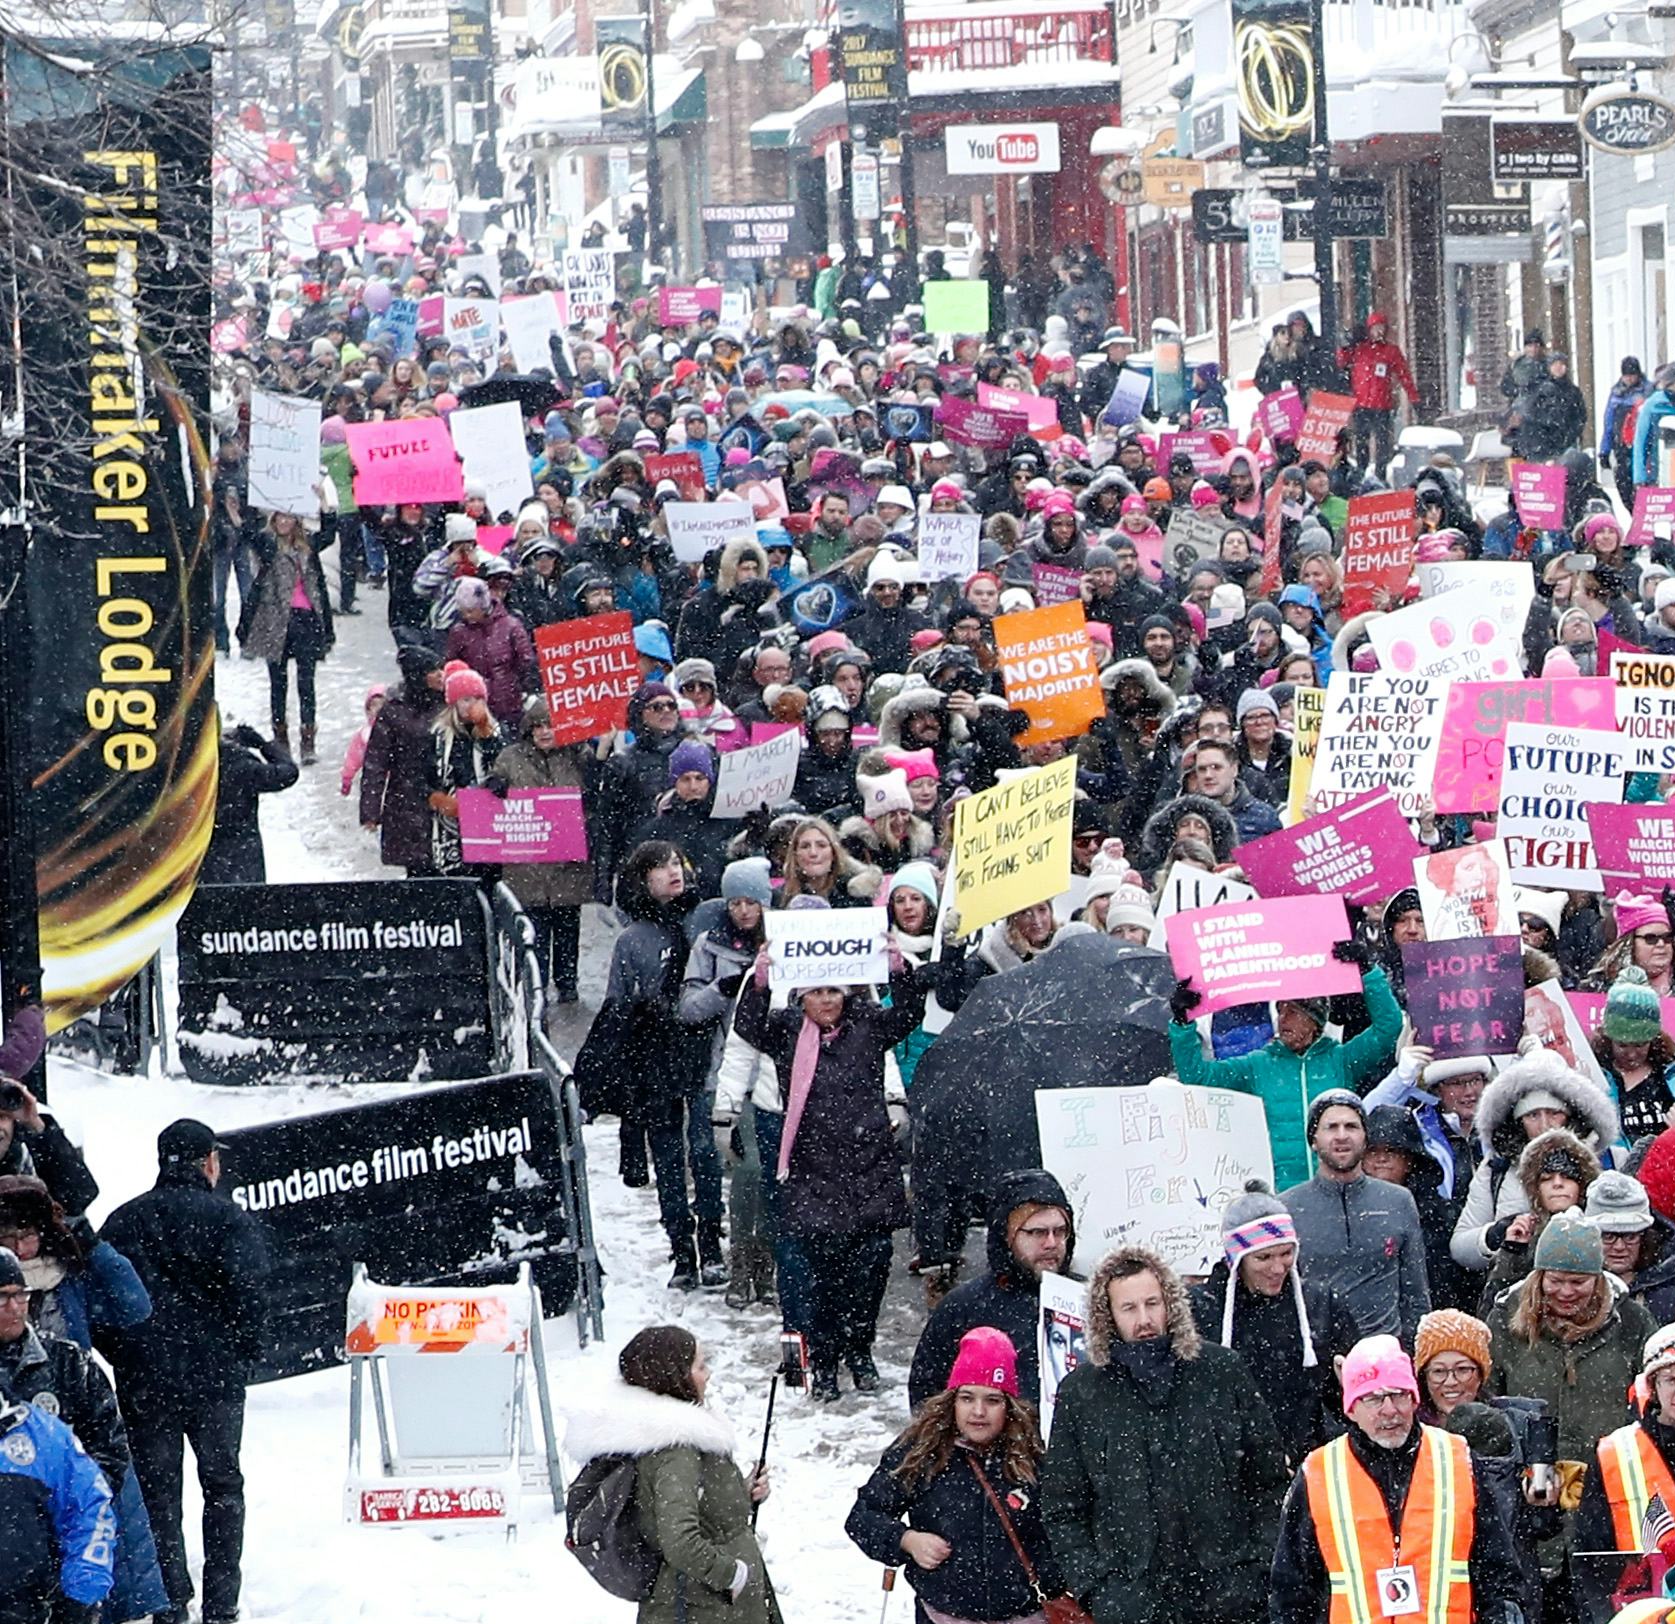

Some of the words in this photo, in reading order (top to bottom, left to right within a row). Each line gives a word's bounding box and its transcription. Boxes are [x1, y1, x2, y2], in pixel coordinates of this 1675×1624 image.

[1595, 107, 1666, 129] PEARLS
[967, 135, 1037, 162] YouTube
[368, 439, 430, 460] FUTURE
[651, 463, 699, 481] WOMEN
[1350, 515, 1370, 528] THE
[1372, 508, 1412, 526] FUTURE
[1349, 529, 1364, 548] IS
[1368, 527, 1411, 548] STILL
[1347, 550, 1410, 572] FEMALE
[543, 644, 572, 660] THE
[574, 632, 630, 650] FUTURE
[1000, 642, 1025, 659] WE
[1027, 636, 1055, 655] ARE
[1057, 629, 1086, 649] THE
[86, 556, 171, 772] Lodge
[547, 666, 568, 685] IS
[571, 652, 635, 674] STILL
[1004, 648, 1091, 685] NOISY
[551, 676, 640, 712] FEMALE
[1008, 674, 1096, 703] MAJORITY
[1350, 678, 1371, 693] IF
[1385, 678, 1428, 695] YOU
[1337, 698, 1386, 714] ARE
[1391, 698, 1438, 714] NOT
[1634, 697, 1653, 713] IS
[1347, 715, 1424, 733] ANGRY
[740, 740, 793, 764] MARCH
[1325, 736, 1376, 752] THEN
[1380, 735, 1431, 751] YOU
[1331, 753, 1376, 770] ARE
[1380, 753, 1421, 769] NOT
[1508, 746, 1622, 778] FUTURE
[1636, 746, 1656, 766] IN
[727, 776, 788, 805] WOMEN
[1021, 768, 1070, 802] BELIEVE
[1341, 771, 1417, 788] PAYING
[963, 835, 991, 858] STILL
[996, 818, 1026, 842] HAVE
[1027, 836, 1052, 864] SHIT
[1204, 912, 1263, 931] STAND
[201, 927, 316, 954] sundance
[321, 923, 369, 950] film
[374, 920, 462, 948] festival
[784, 939, 872, 957] ENOUGH
[1200, 932, 1246, 950] WITH
[1200, 942, 1282, 967] PLANNED
[1427, 953, 1498, 975] HOPE
[1203, 955, 1326, 981] PARENTHOOD
[1438, 989, 1493, 1010] NOT
[1433, 1023, 1504, 1043] FEAR
[232, 1161, 368, 1212] sundance
[372, 1146, 428, 1184] film
[434, 1118, 532, 1168] festival
[383, 1302, 410, 1319] NO
